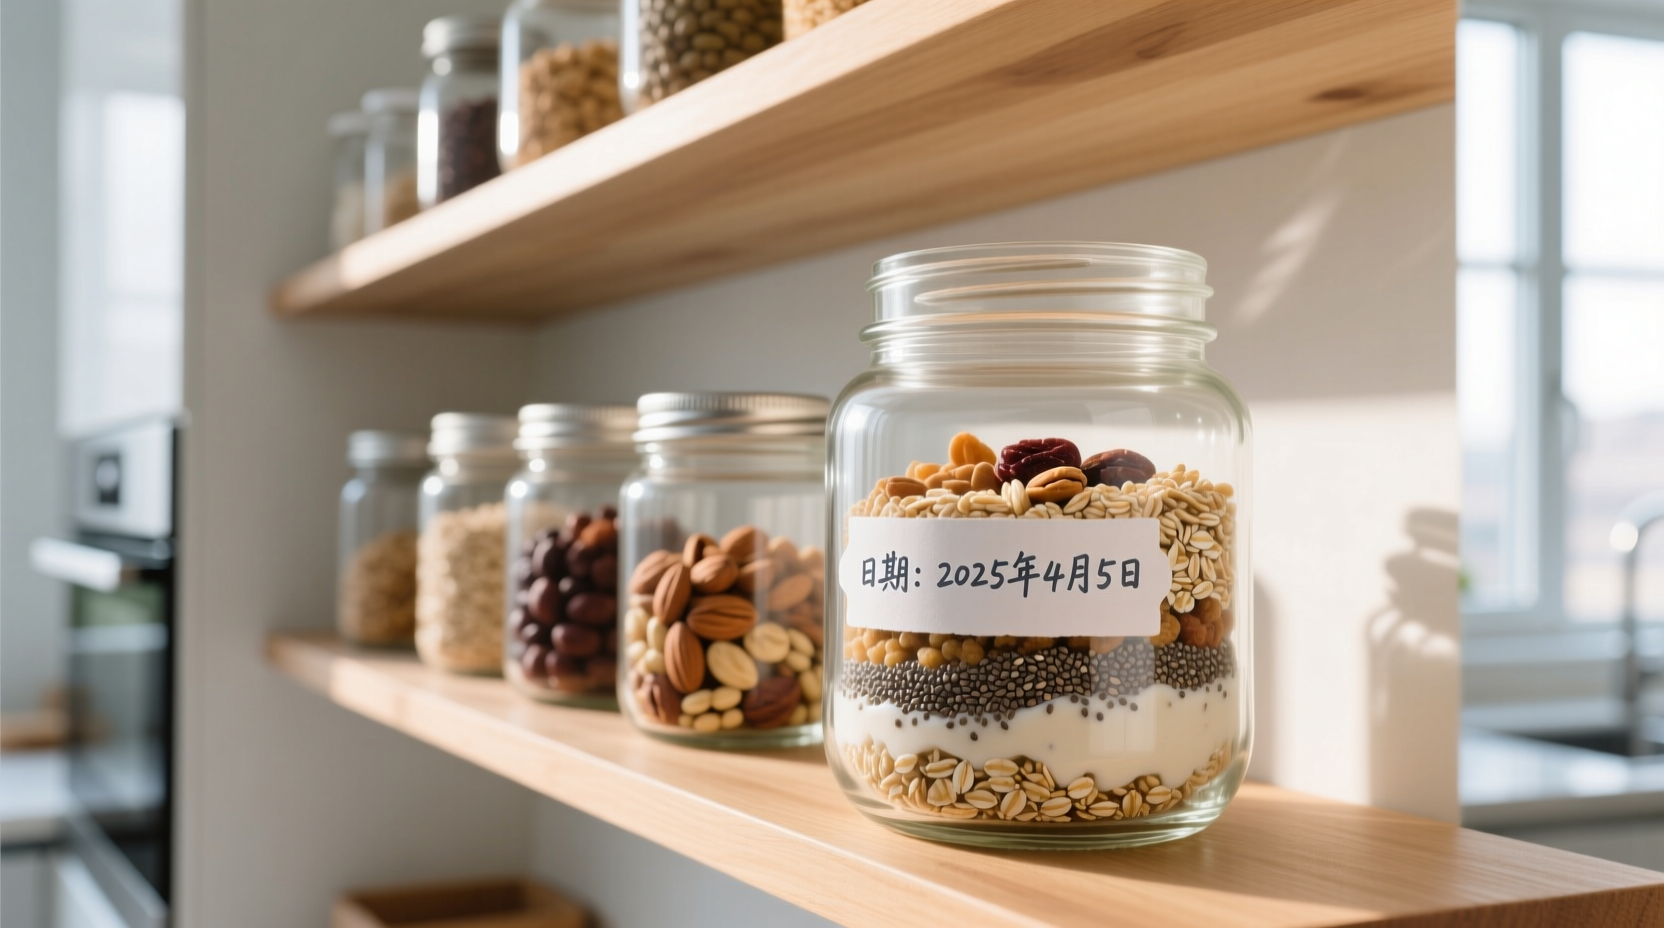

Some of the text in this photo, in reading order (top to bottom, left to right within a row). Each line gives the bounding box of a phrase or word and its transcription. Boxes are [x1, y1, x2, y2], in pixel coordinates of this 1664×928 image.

[862, 549, 1141, 599] 日期: 2025年4月5日
